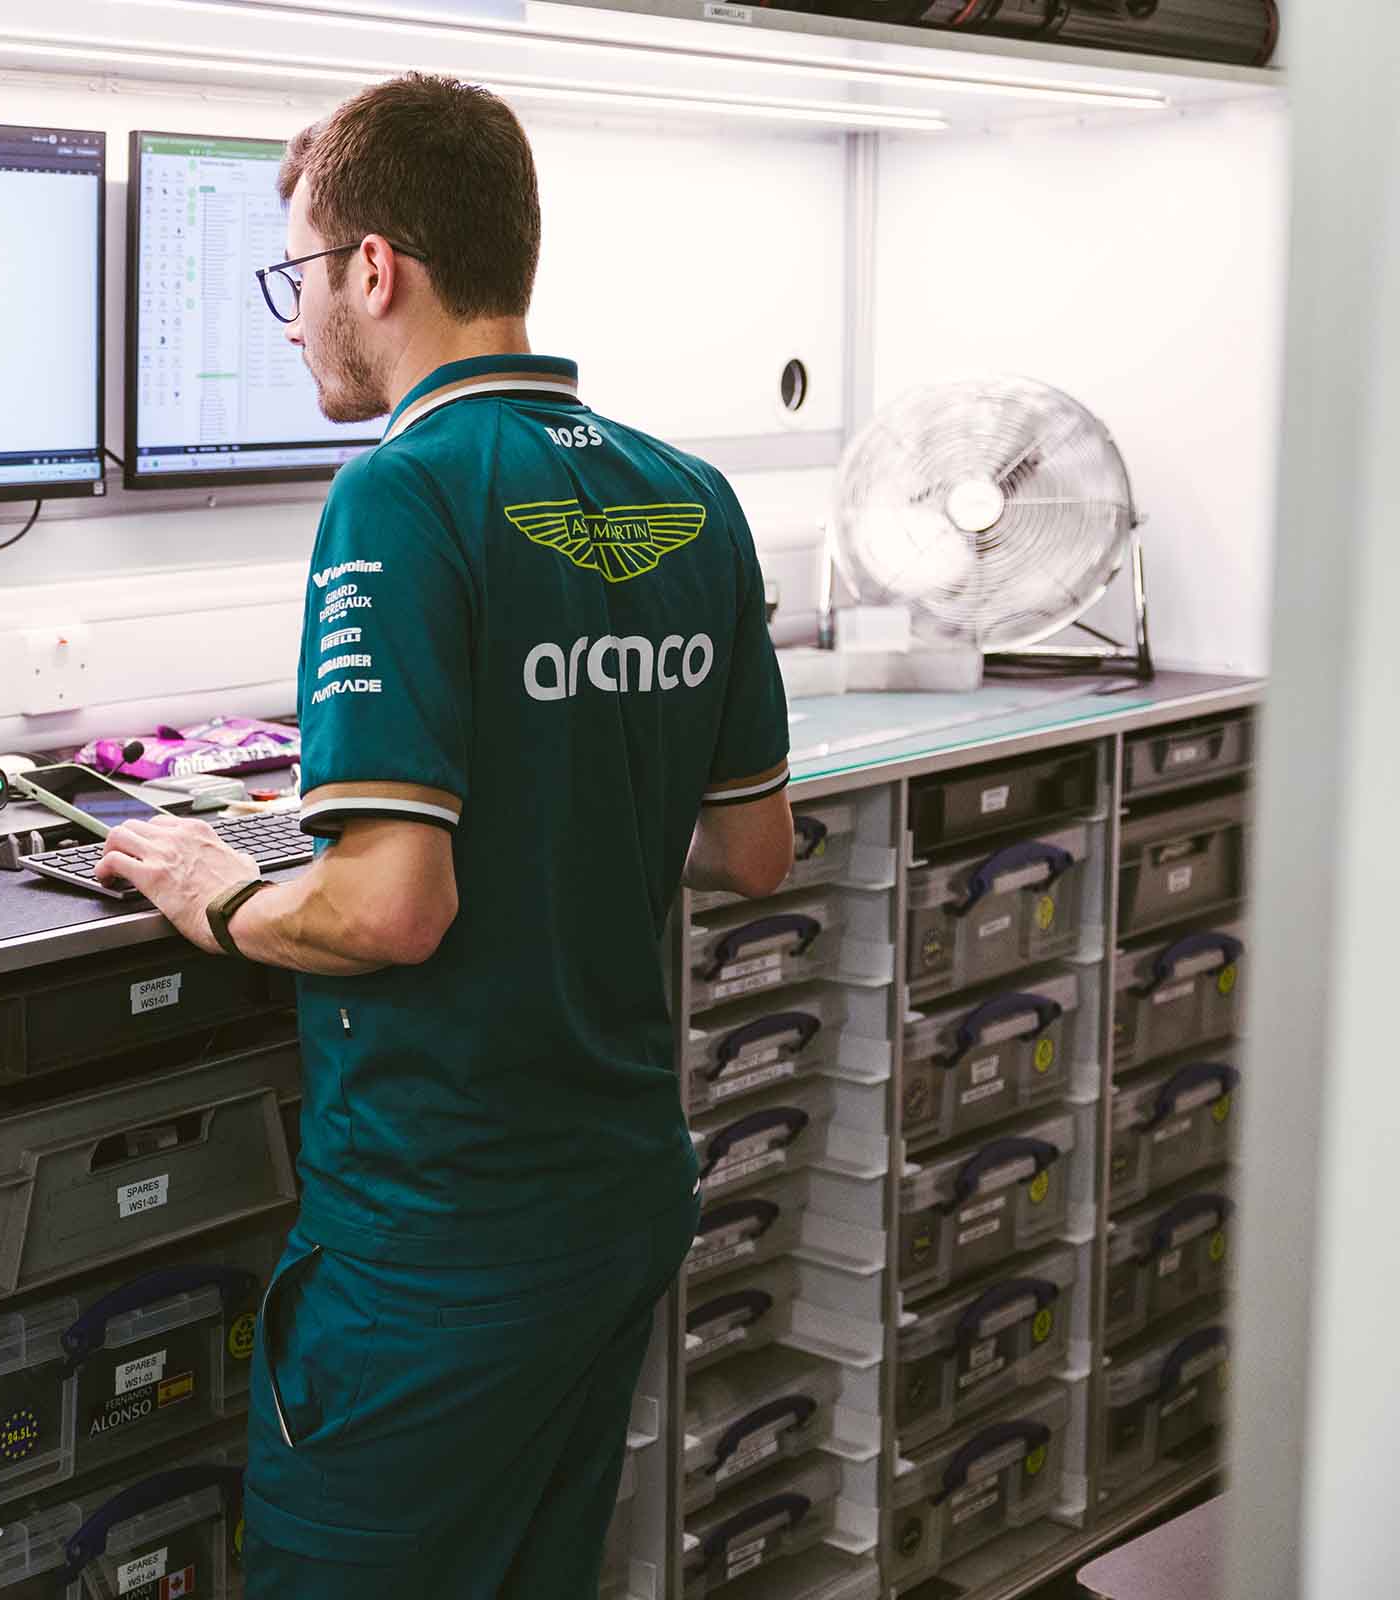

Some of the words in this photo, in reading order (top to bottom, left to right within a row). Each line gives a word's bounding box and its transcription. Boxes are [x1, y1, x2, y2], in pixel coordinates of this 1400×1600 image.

[593, 522, 648, 540] MARTIN
[140, 979, 172, 993] SPARES
[127, 1180, 160, 1198] SPARES
[125, 1356, 157, 1375] SPARES
[90, 1399, 152, 1435] ALONSO
[127, 1553, 159, 1575] SPARES
